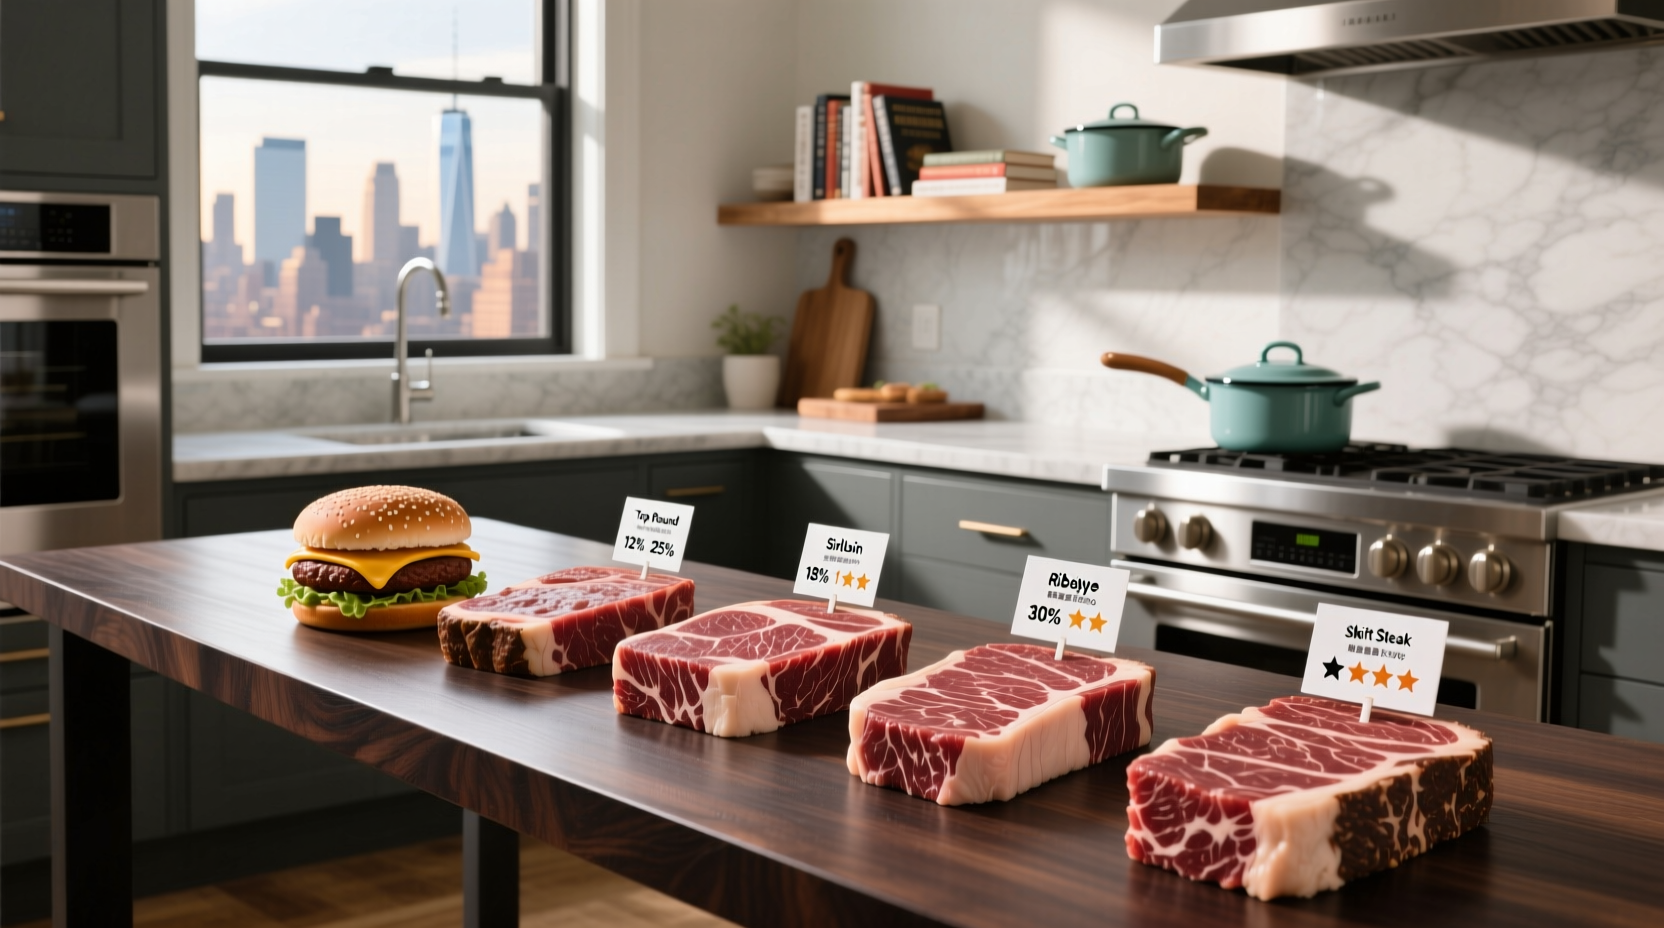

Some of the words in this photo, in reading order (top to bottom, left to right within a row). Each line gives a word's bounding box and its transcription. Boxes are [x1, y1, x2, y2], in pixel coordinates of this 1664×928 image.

[624, 535, 645, 551] 12%
[649, 540, 675, 557] 25%
[1027, 604, 1061, 625] 30%
